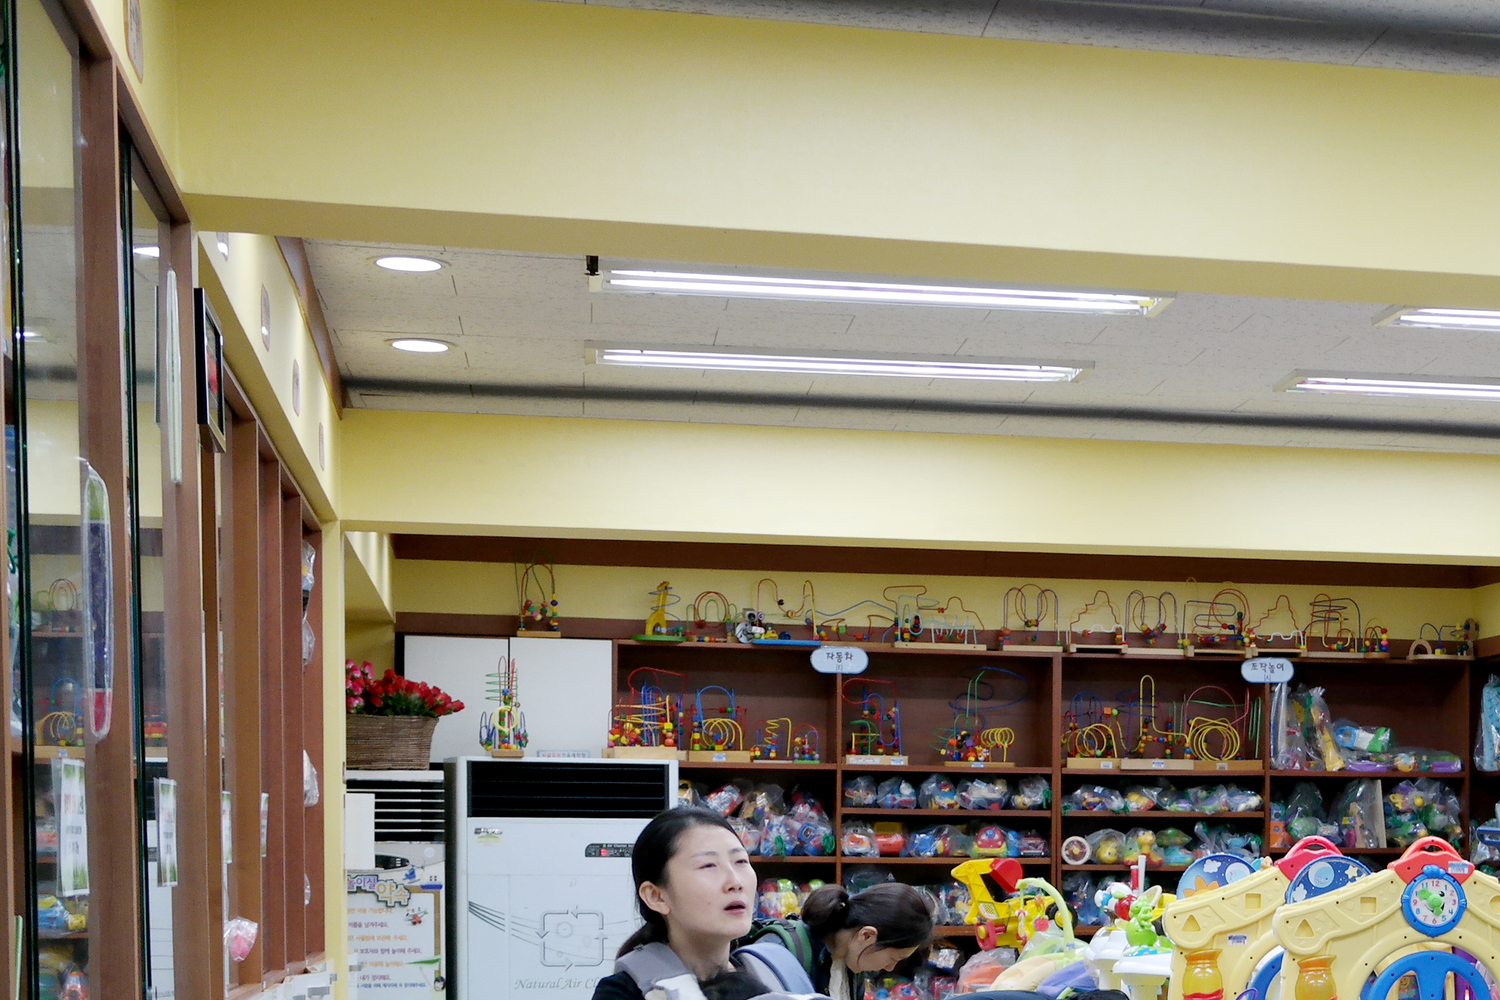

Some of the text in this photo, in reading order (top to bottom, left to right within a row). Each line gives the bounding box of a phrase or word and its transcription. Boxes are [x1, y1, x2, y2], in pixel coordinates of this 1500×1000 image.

[1250, 662, 1285, 674] 조작놀이
[376, 881, 409, 905] 약속
[514, 978, 562, 990] Natural
[561, 978, 582, 990] Air
